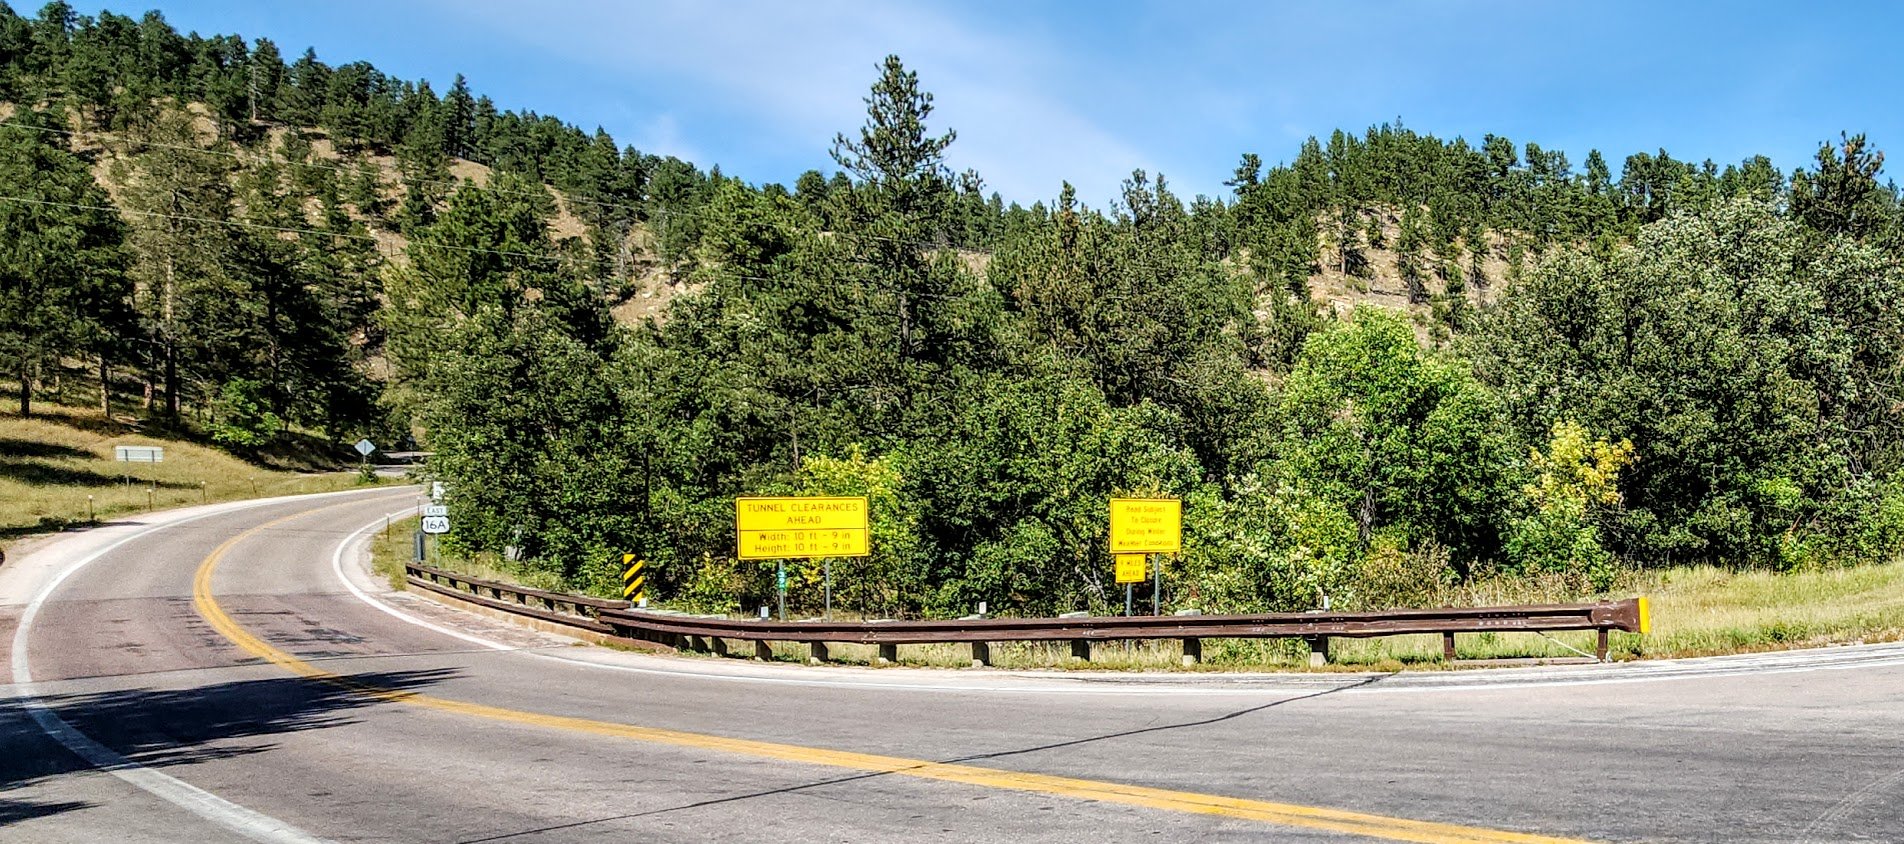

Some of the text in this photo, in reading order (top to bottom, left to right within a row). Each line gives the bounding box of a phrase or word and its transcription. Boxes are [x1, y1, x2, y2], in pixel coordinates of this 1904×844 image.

[747, 503, 858, 512] TUNNEL CLEARANCES
[426, 520, 446, 529] 16A
[786, 516, 822, 524] AHEAD
[760, 532, 790, 541] Width:
[754, 544, 790, 553] Height:
[810, 543, 817, 551] ft
